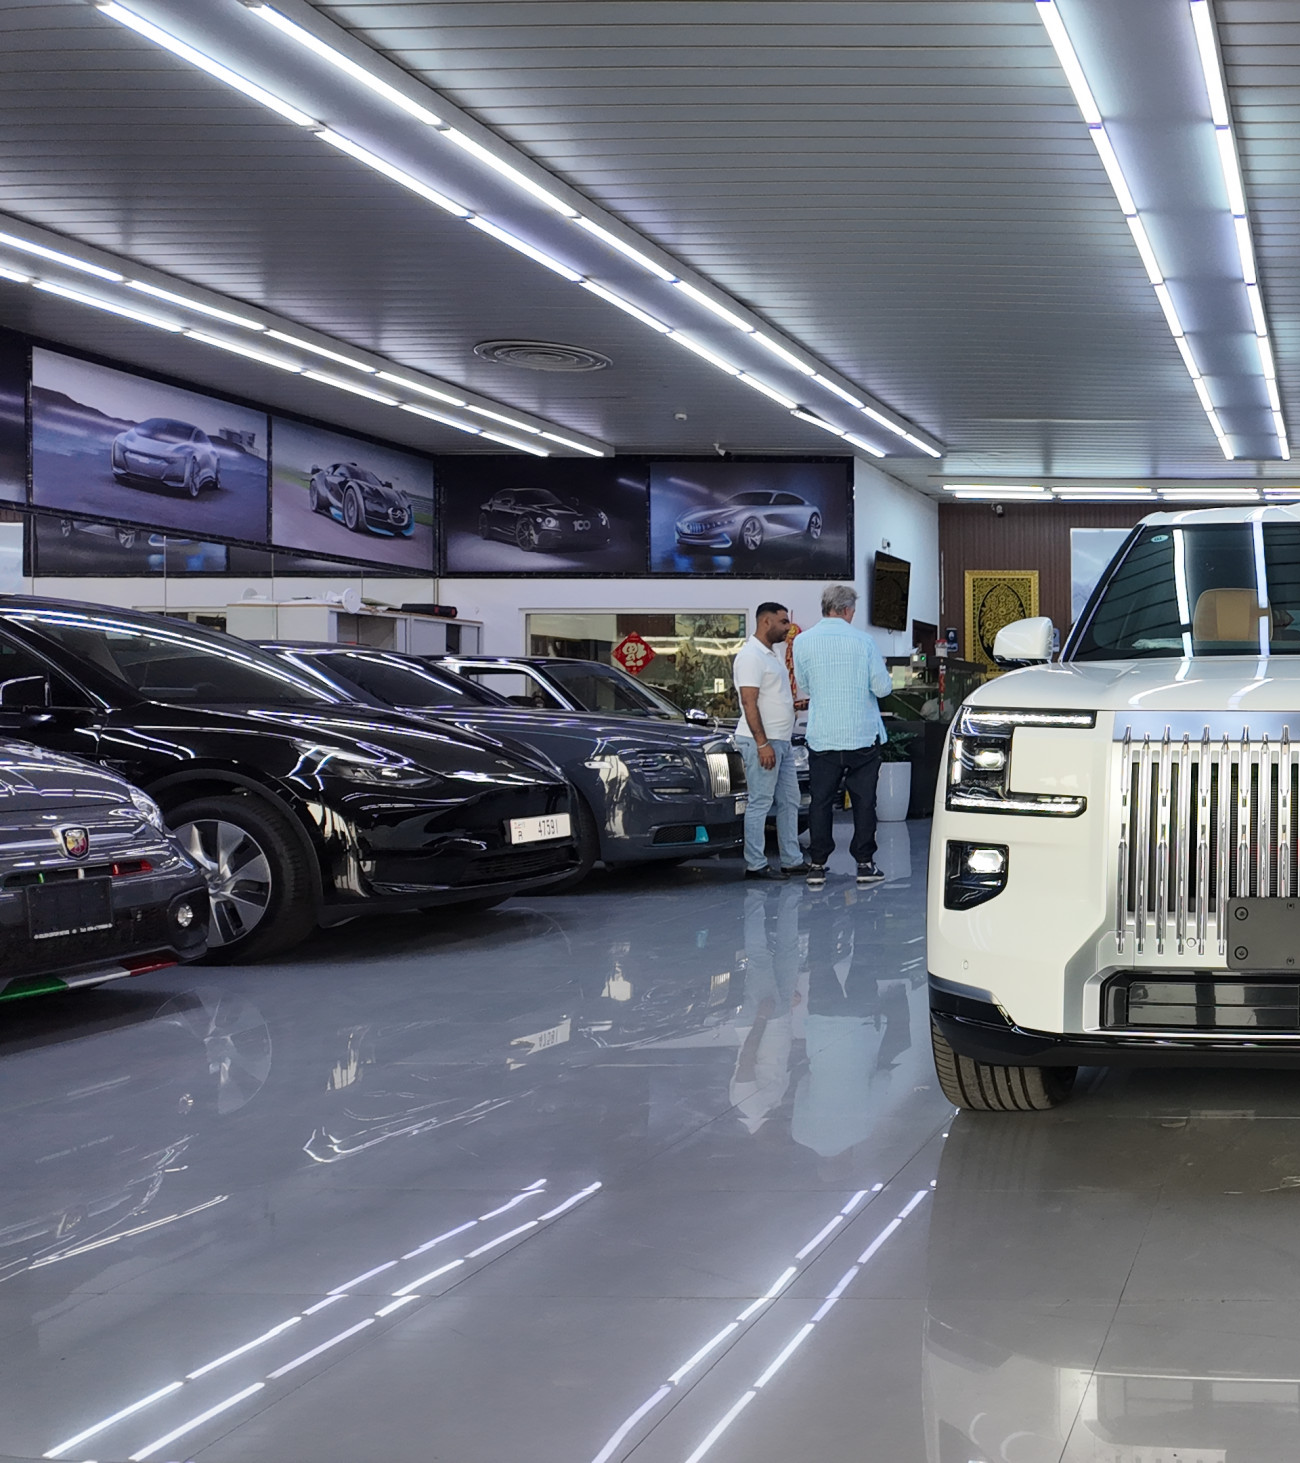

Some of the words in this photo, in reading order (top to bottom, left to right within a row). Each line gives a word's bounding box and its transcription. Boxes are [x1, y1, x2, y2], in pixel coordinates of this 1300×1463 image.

[572, 520, 591, 531] 100
[622, 642, 647, 667] 福
[538, 819, 558, 837] 47591
